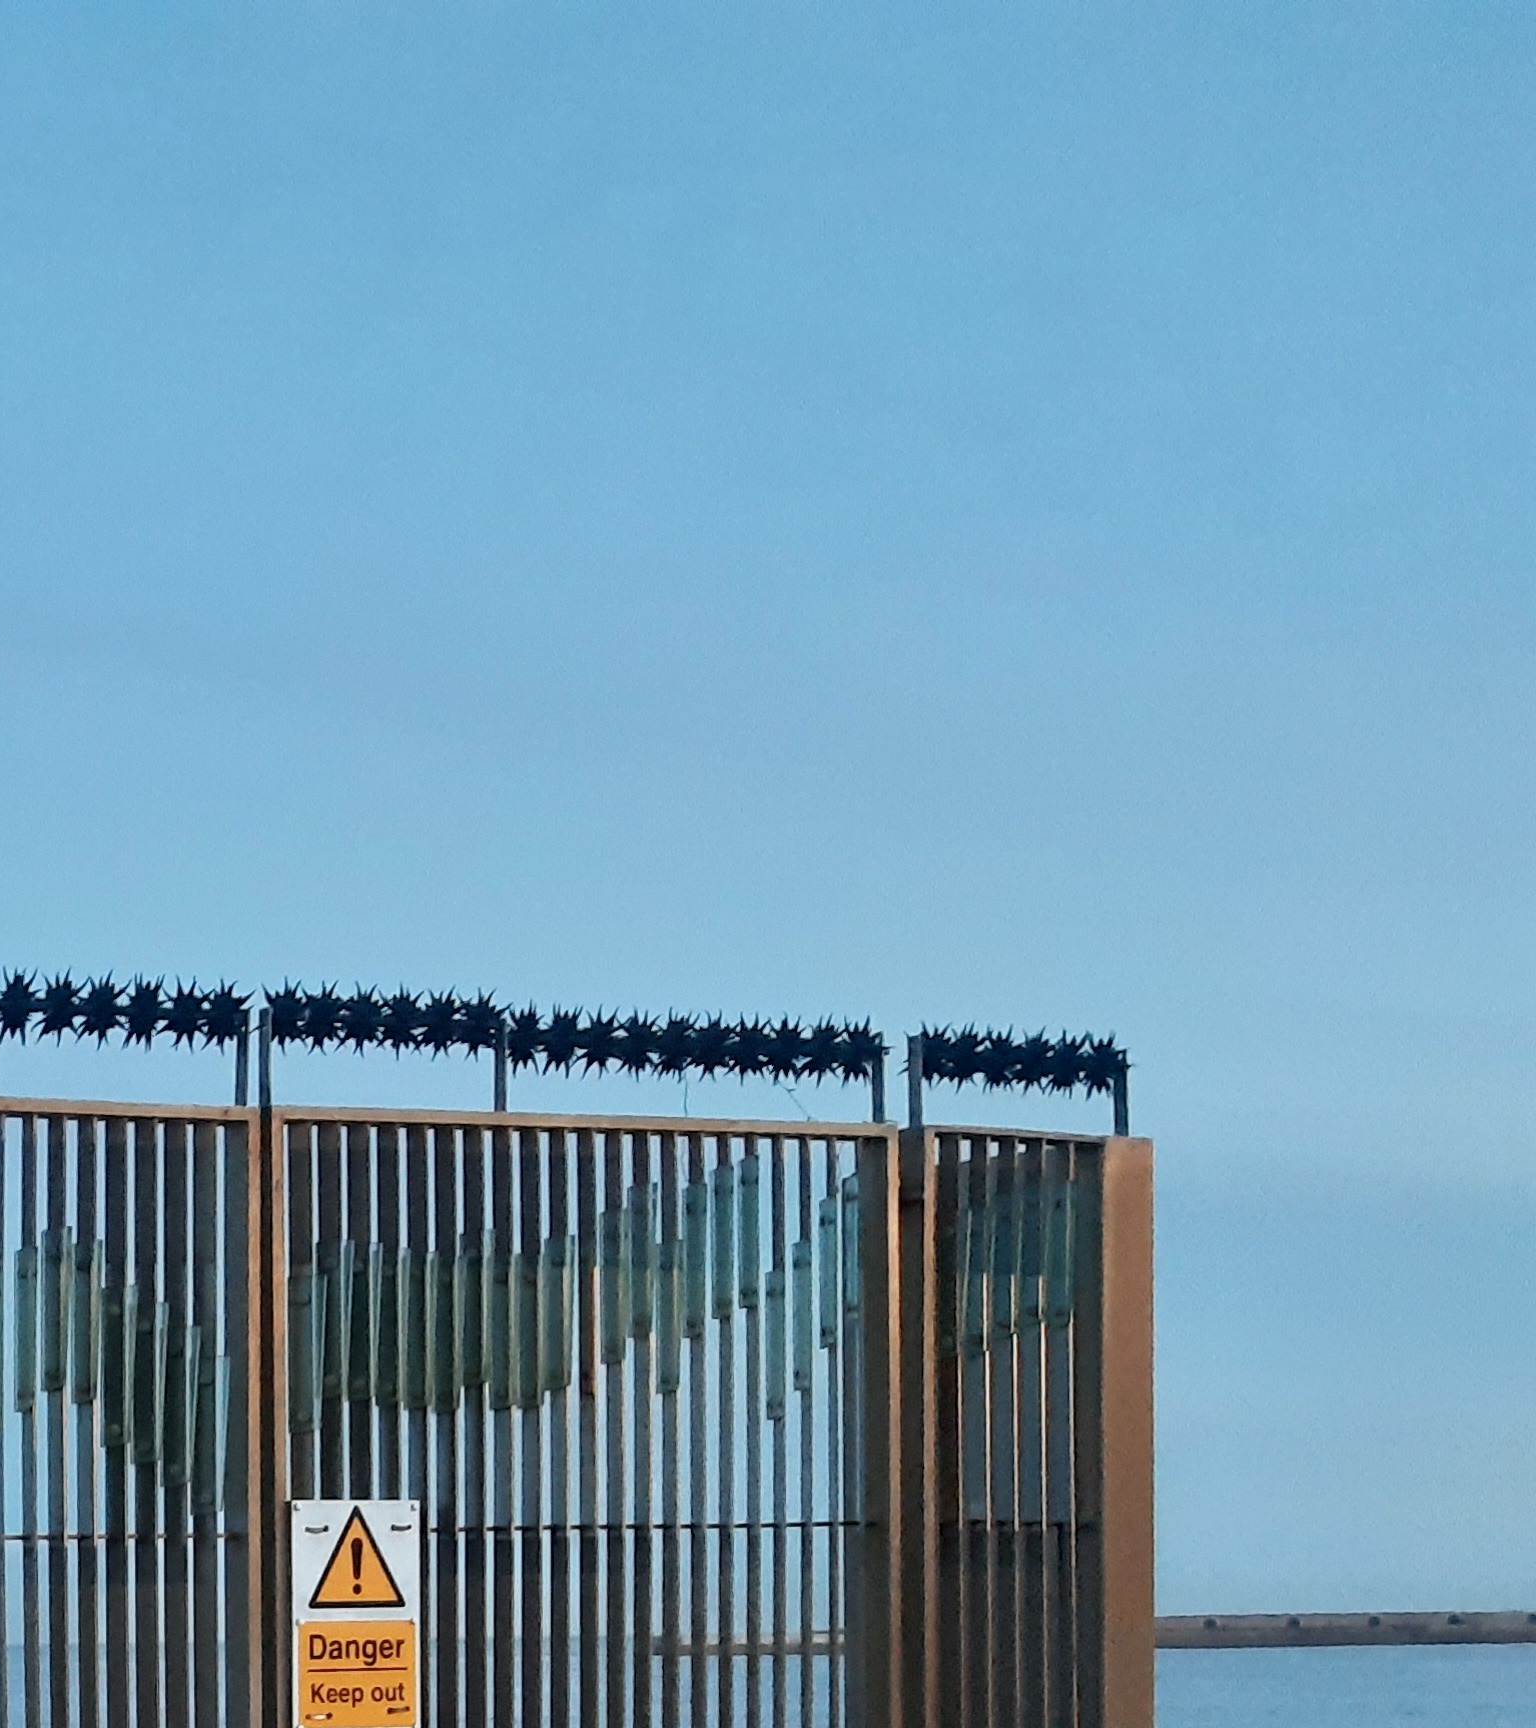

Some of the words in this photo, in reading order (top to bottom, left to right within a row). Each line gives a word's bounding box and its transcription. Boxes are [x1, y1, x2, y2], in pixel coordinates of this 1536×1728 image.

[309, 1634, 406, 1666] Danger
[311, 1683, 364, 1707] Keep
[371, 1683, 405, 1702] out
